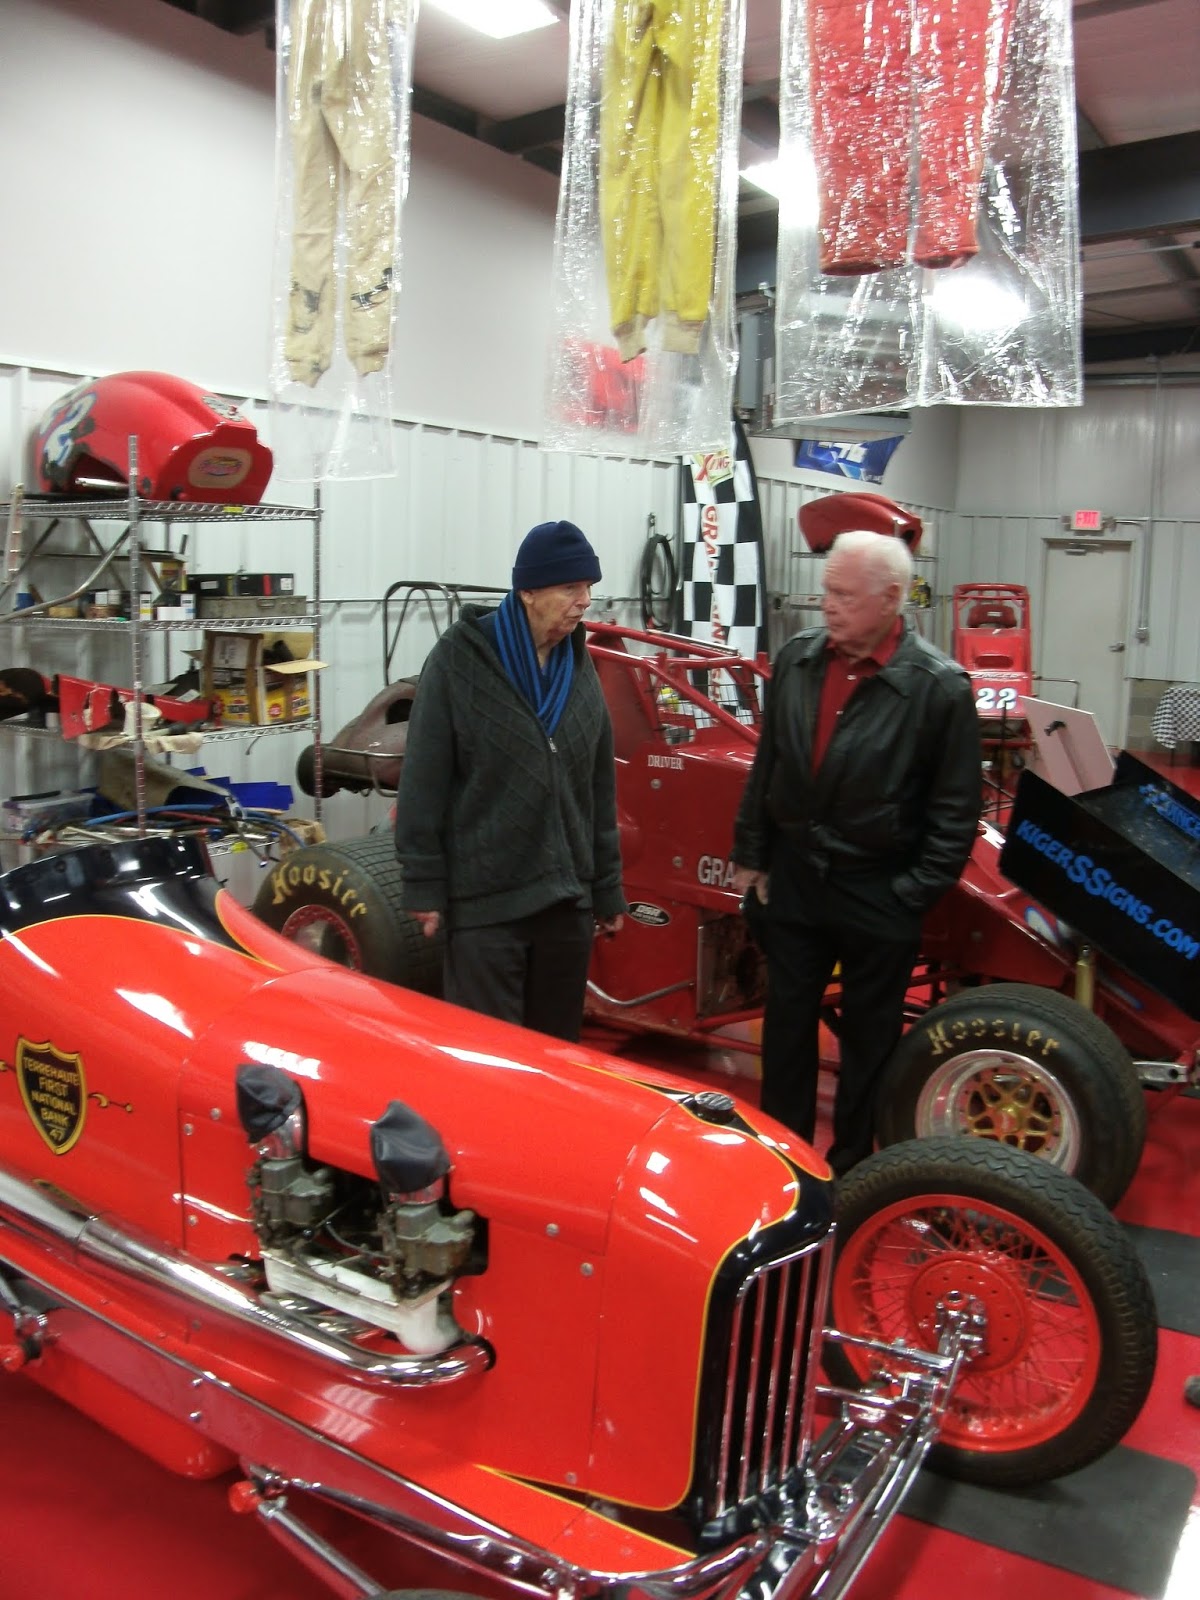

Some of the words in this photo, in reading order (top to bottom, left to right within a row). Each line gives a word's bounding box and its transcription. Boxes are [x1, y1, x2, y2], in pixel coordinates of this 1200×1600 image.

[1075, 511, 1098, 528] EXIT
[975, 687, 1017, 710] 22
[647, 754, 685, 770] DRIVER
[697, 855, 738, 890] GRA
[271, 861, 368, 918] Hoosier
[926, 1020, 1060, 1056] Hoosier
[39, 1076, 69, 1097] FIRST
[31, 1090, 78, 1116] NATIONAL
[41, 1107, 69, 1128] BANK
